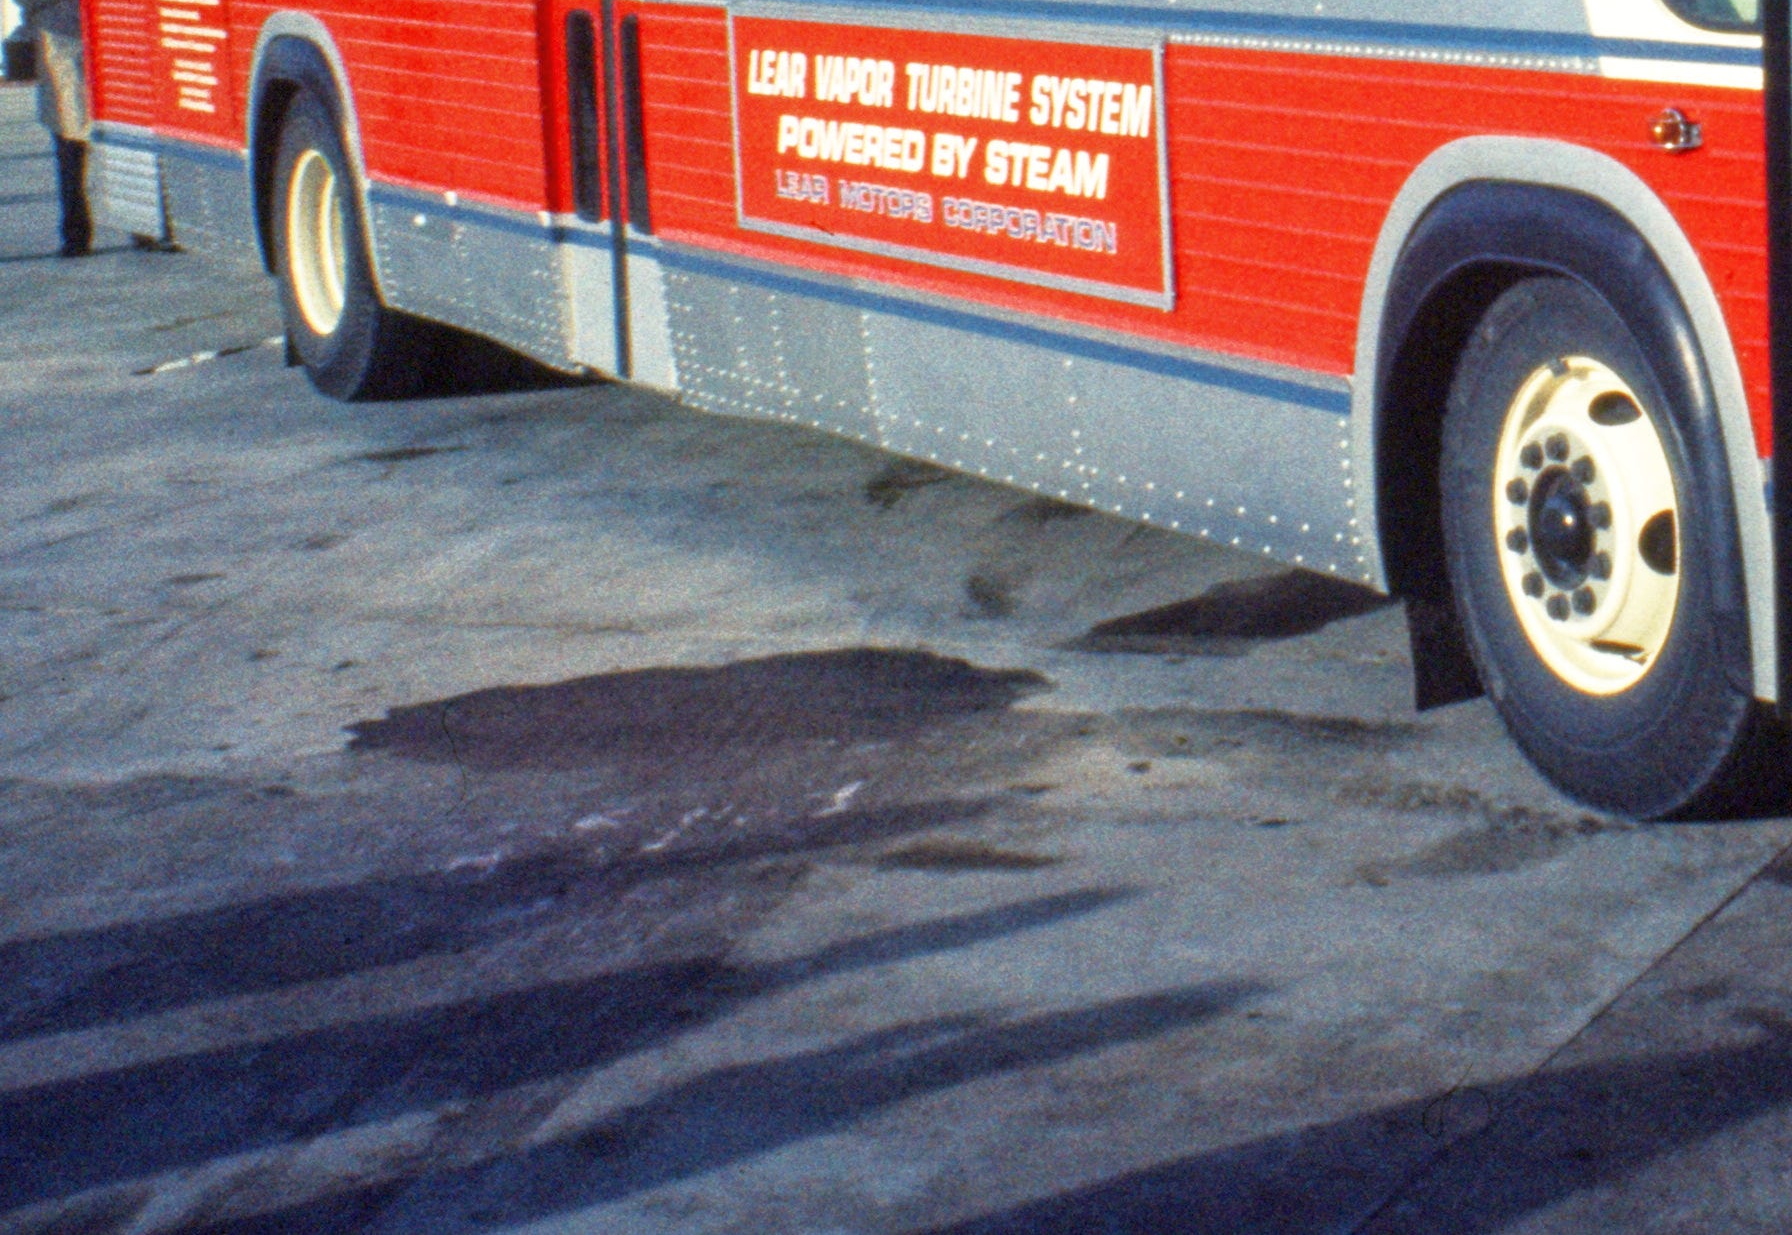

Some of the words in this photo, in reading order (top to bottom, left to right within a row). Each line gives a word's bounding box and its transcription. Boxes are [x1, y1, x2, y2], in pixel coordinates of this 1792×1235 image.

[748, 49, 807, 98] LEAR
[815, 54, 894, 108] VAPOR
[906, 62, 1022, 123] TURBINE
[1030, 74, 1152, 138] SYSTEM
[777, 114, 925, 172] POWERED
[931, 133, 977, 178] BY
[984, 139, 1109, 199] STEAM
[775, 169, 829, 205] LEAR
[838, 180, 932, 223] MOTORS
[942, 196, 1117, 254] CORPORATION
